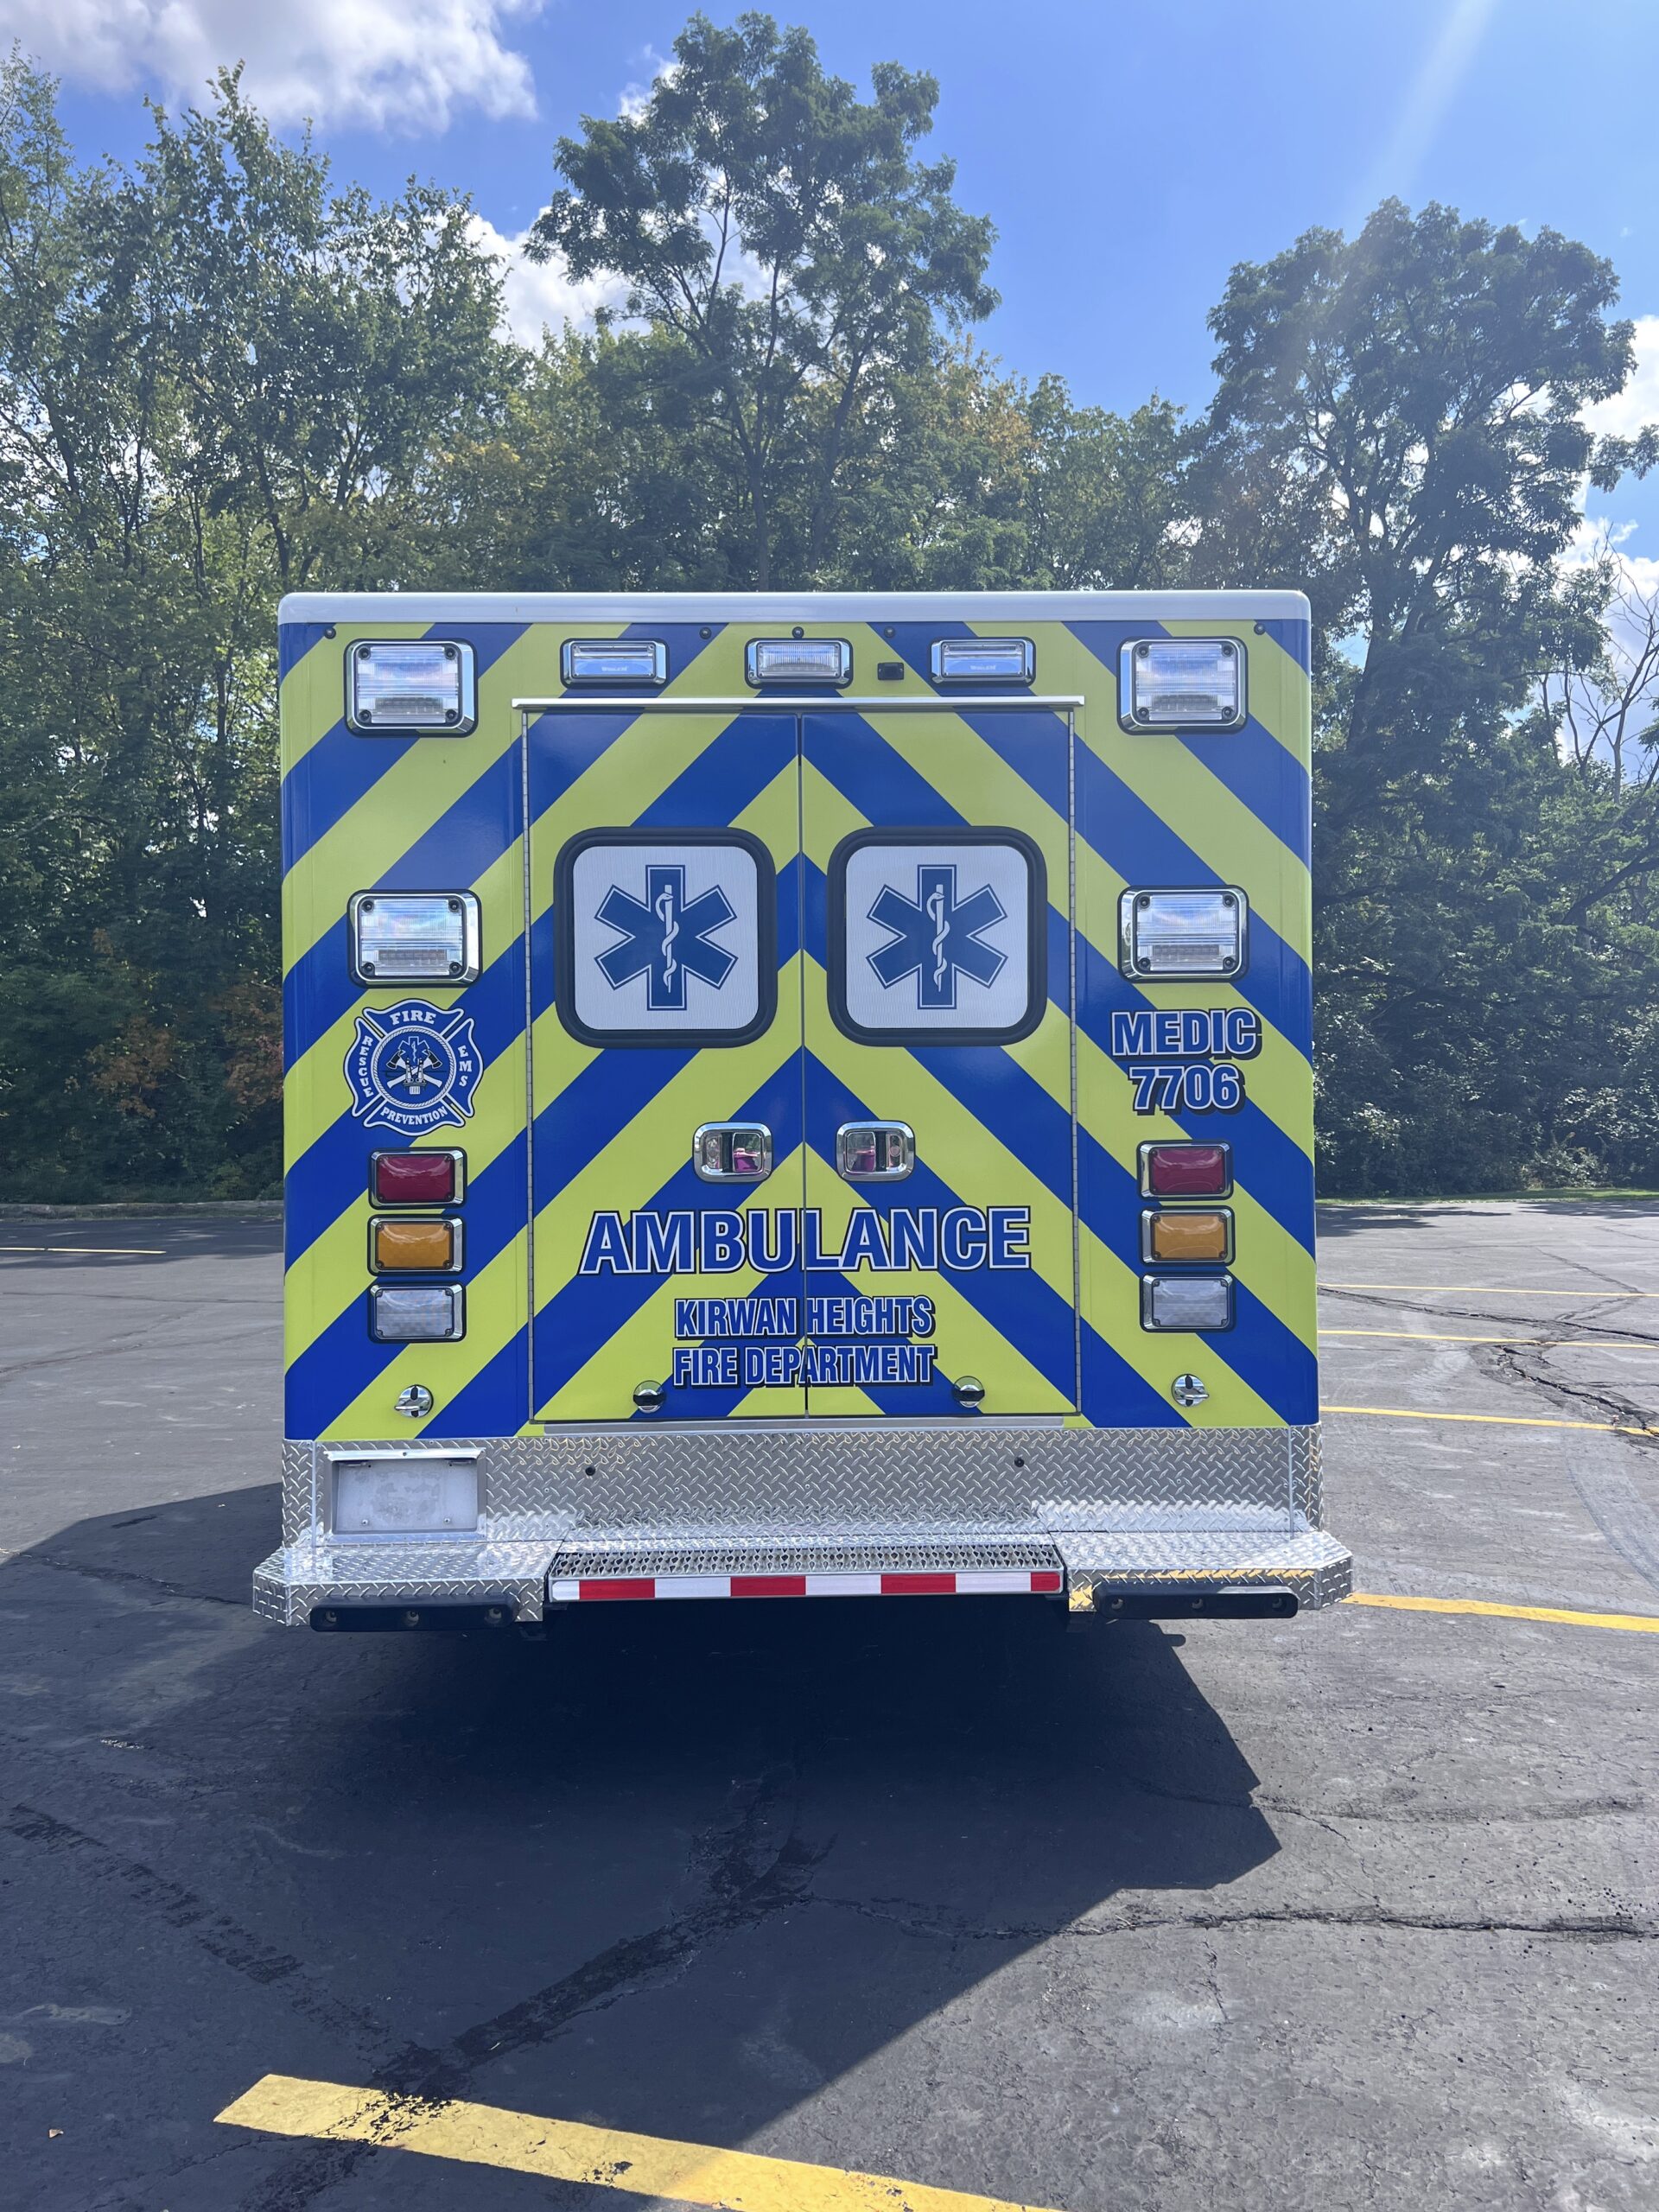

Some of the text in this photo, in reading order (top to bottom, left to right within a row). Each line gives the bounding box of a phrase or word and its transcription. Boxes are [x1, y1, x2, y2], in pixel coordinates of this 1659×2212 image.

[389, 1009, 437, 1026] FIRE
[1111, 1007, 1262, 1059] MEDIC
[358, 1035, 374, 1098] RESCUE
[457, 1045, 473, 1087] EMS
[1128, 1063, 1245, 1116] 7706
[379, 1105, 448, 1126] PREVENTION
[577, 1206, 1033, 1275] AMBULANCE
[675, 1295, 936, 1340] KIRWAN HEIGHTS
[672, 1344, 938, 1389] FIRE DEPARTMENT
